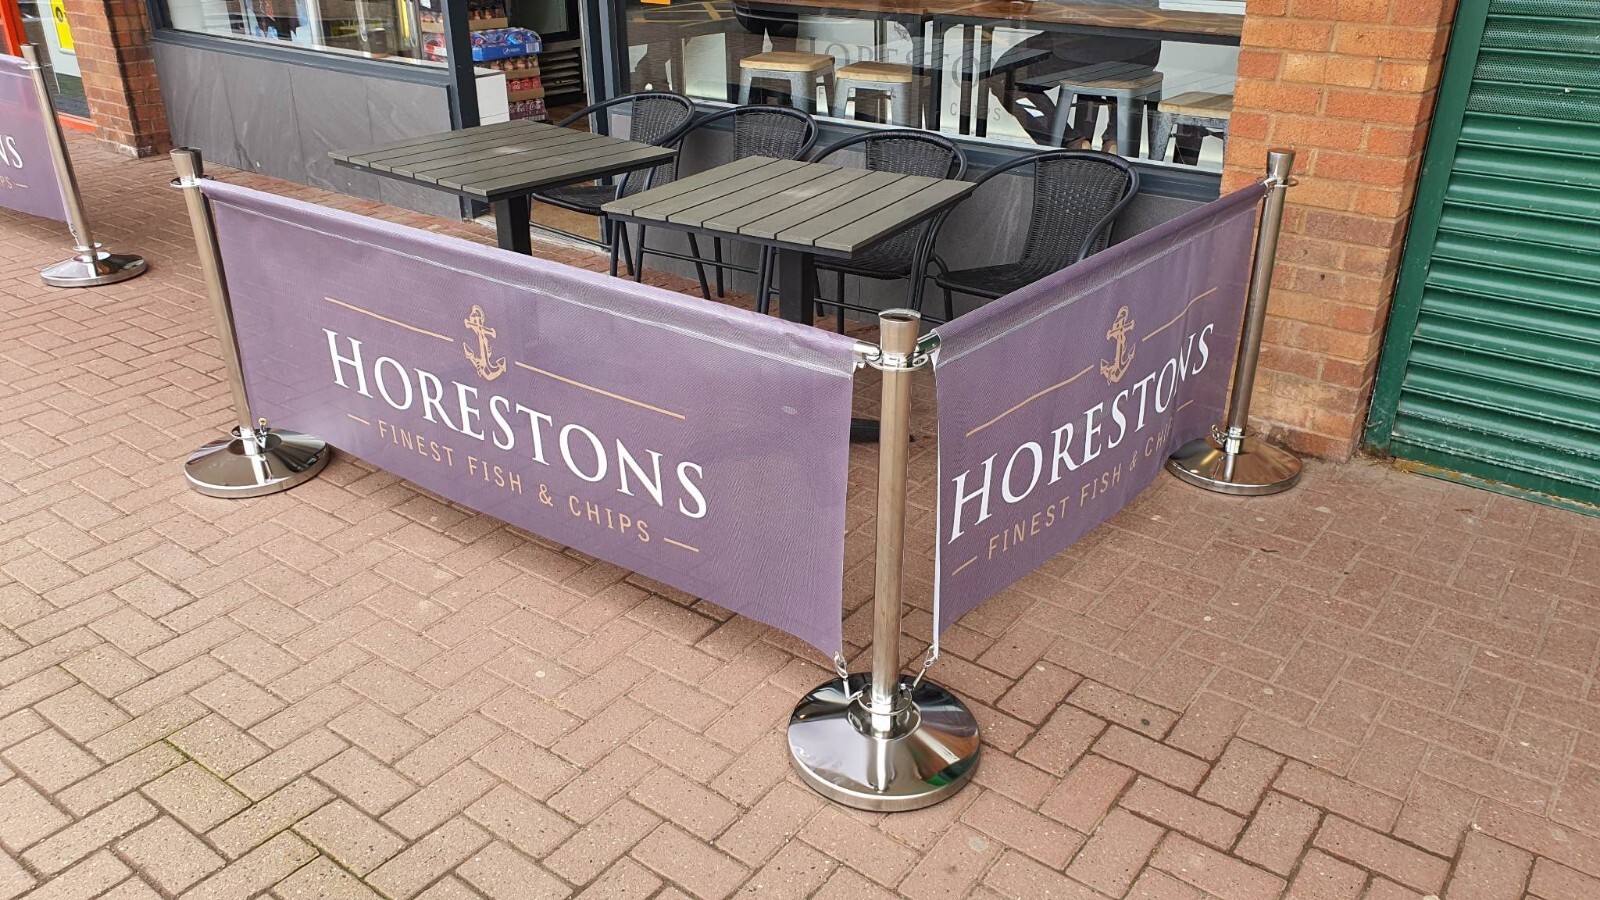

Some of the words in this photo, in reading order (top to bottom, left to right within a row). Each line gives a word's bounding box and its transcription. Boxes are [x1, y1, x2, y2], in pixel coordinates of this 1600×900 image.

[322, 328, 708, 519] HORESTONS
[378, 419, 454, 468] FINEST
[468, 455, 523, 495] FISH
[538, 483, 554, 507] &
[569, 495, 651, 543] CHIPS
[948, 323, 1214, 545] HORESTONS
[988, 496, 1069, 560] FINEST
[1080, 461, 1122, 507] FISH
[1129, 450, 1138, 472] &
